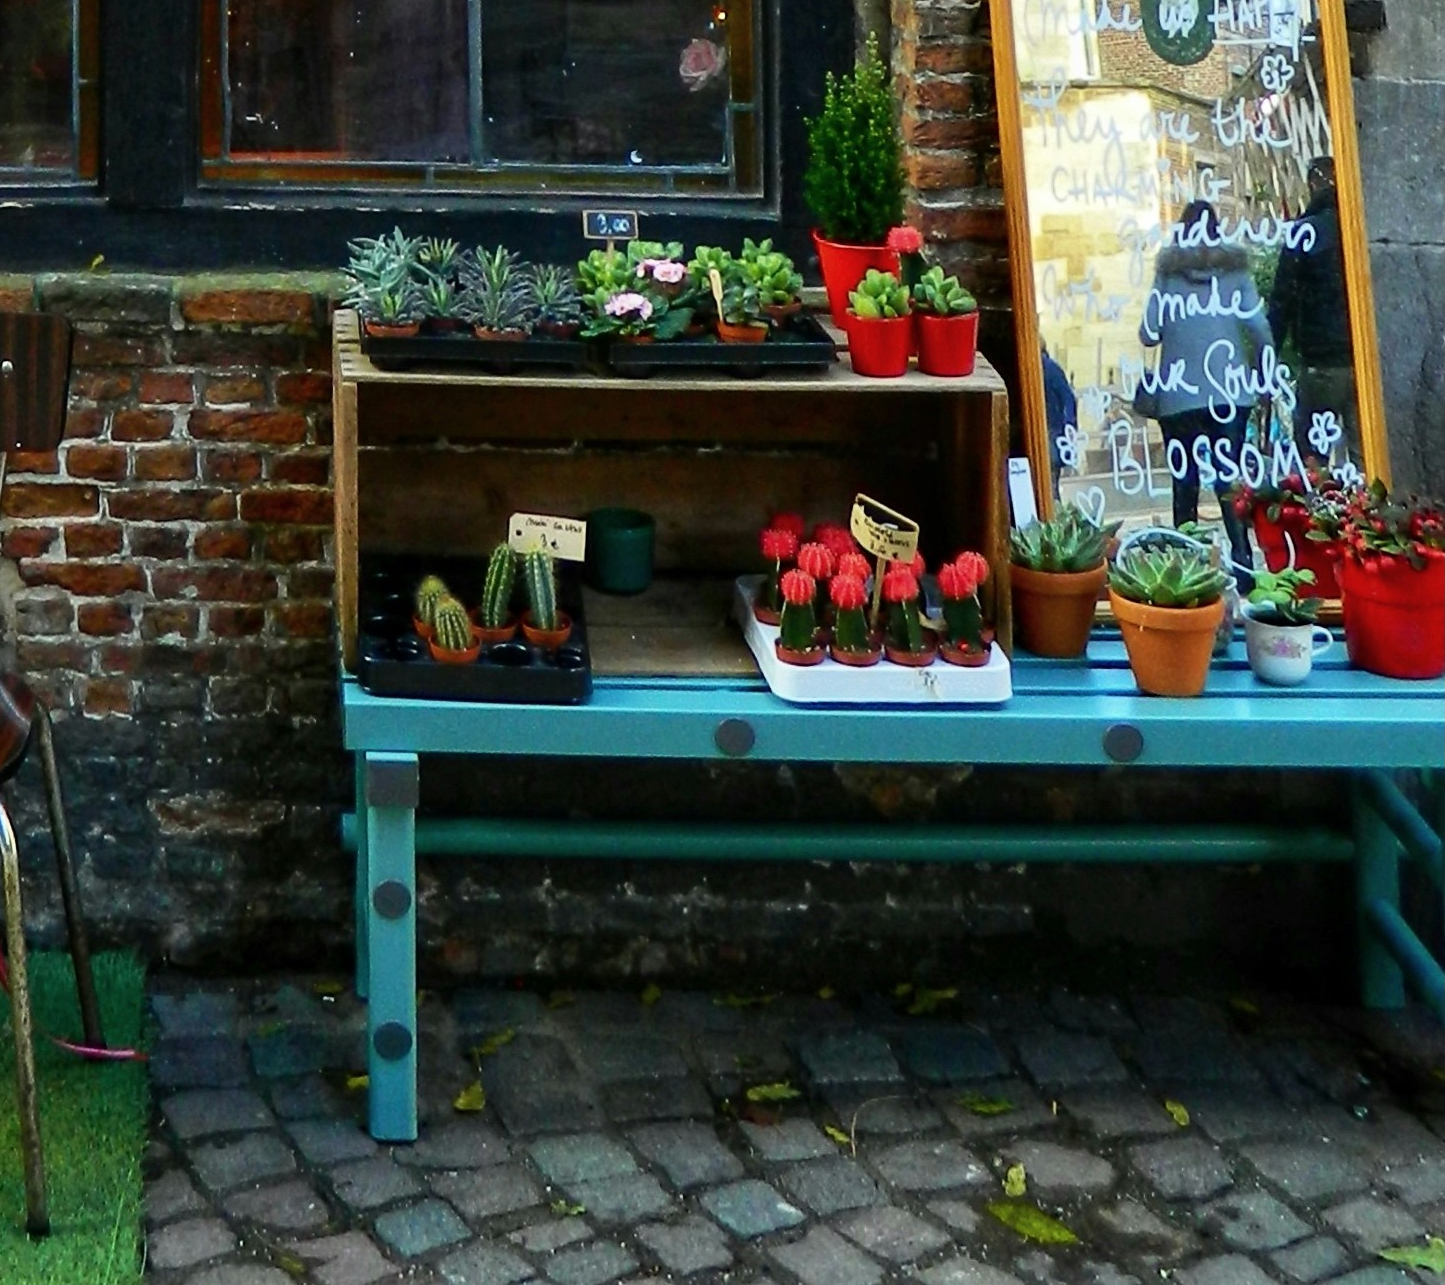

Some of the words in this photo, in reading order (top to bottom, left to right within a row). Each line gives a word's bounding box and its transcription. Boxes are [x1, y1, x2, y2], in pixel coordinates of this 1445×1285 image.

[1139, 110, 1200, 145] are
[1212, 96, 1294, 148] the
[1117, 209, 1317, 288] gardeners
[1108, 419, 1313, 497] BLOSSOM
